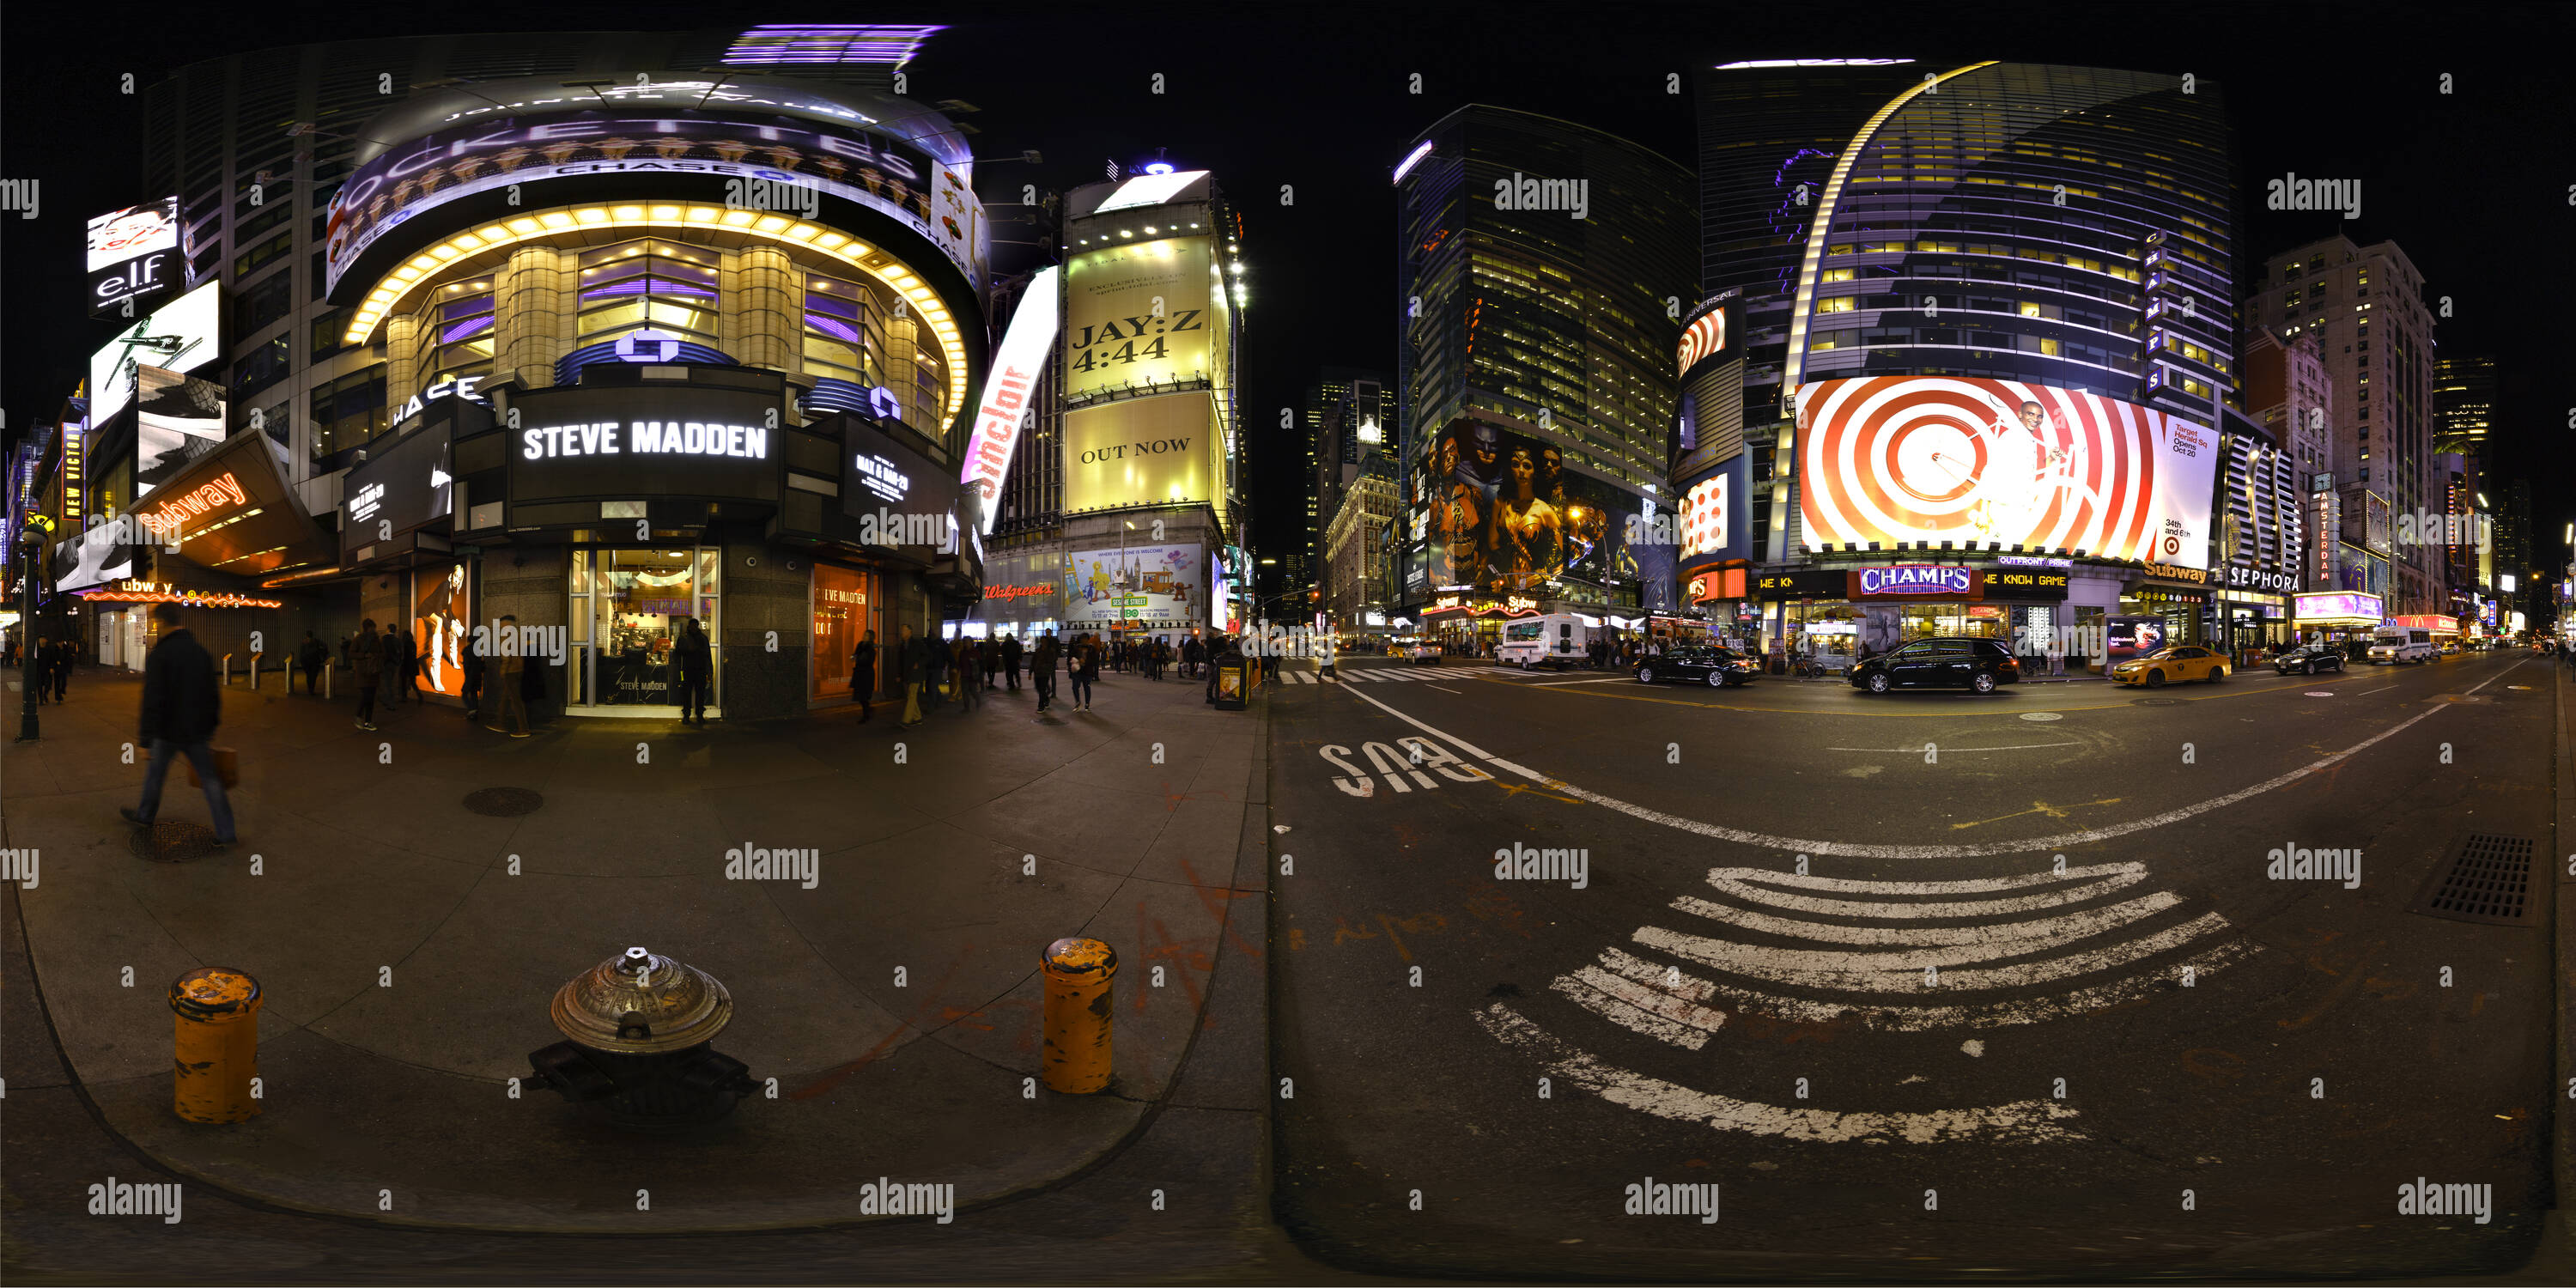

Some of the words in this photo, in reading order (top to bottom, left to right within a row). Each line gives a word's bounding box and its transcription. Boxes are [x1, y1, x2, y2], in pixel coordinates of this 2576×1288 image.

[556, 162, 742, 174] CHASE
[913, 220, 969, 275] CHASE
[1072, 309, 1202, 349] JAY:Z
[1072, 336, 1170, 374] 4:44
[2174, 431, 2197, 444] Herald
[2198, 440, 2208, 449] Sq
[2176, 423, 2198, 437] Target
[524, 422, 619, 460] STEVE
[631, 422, 767, 459] MADDEN
[1081, 445, 1128, 465] OUT
[1135, 437, 1192, 457] NOW
[2172, 445, 2186, 455] Oct
[2173, 438, 2196, 451] Opens
[66, 425, 80, 480] VICTORY
[66, 487, 80, 516] NEW
[138, 472, 246, 534] Subway
[2165, 527, 2178, 536] and
[2166, 519, 2181, 529] 34th
[2320, 491, 2330, 580] AMSTERDAM
[1999, 556, 2045, 566] OUTFRONT
[1862, 568, 1969, 592] CHAMPS
[1984, 574, 1997, 584] WE
[2004, 574, 2033, 585] KNOW
[2038, 575, 2067, 586] GAME
[2144, 560, 2208, 585] Subway
[983, 583, 1054, 603] Walgreens
[1759, 578, 1775, 588] WE
[620, 682, 640, 690] STEVE
[641, 682, 667, 691] MADDEN
